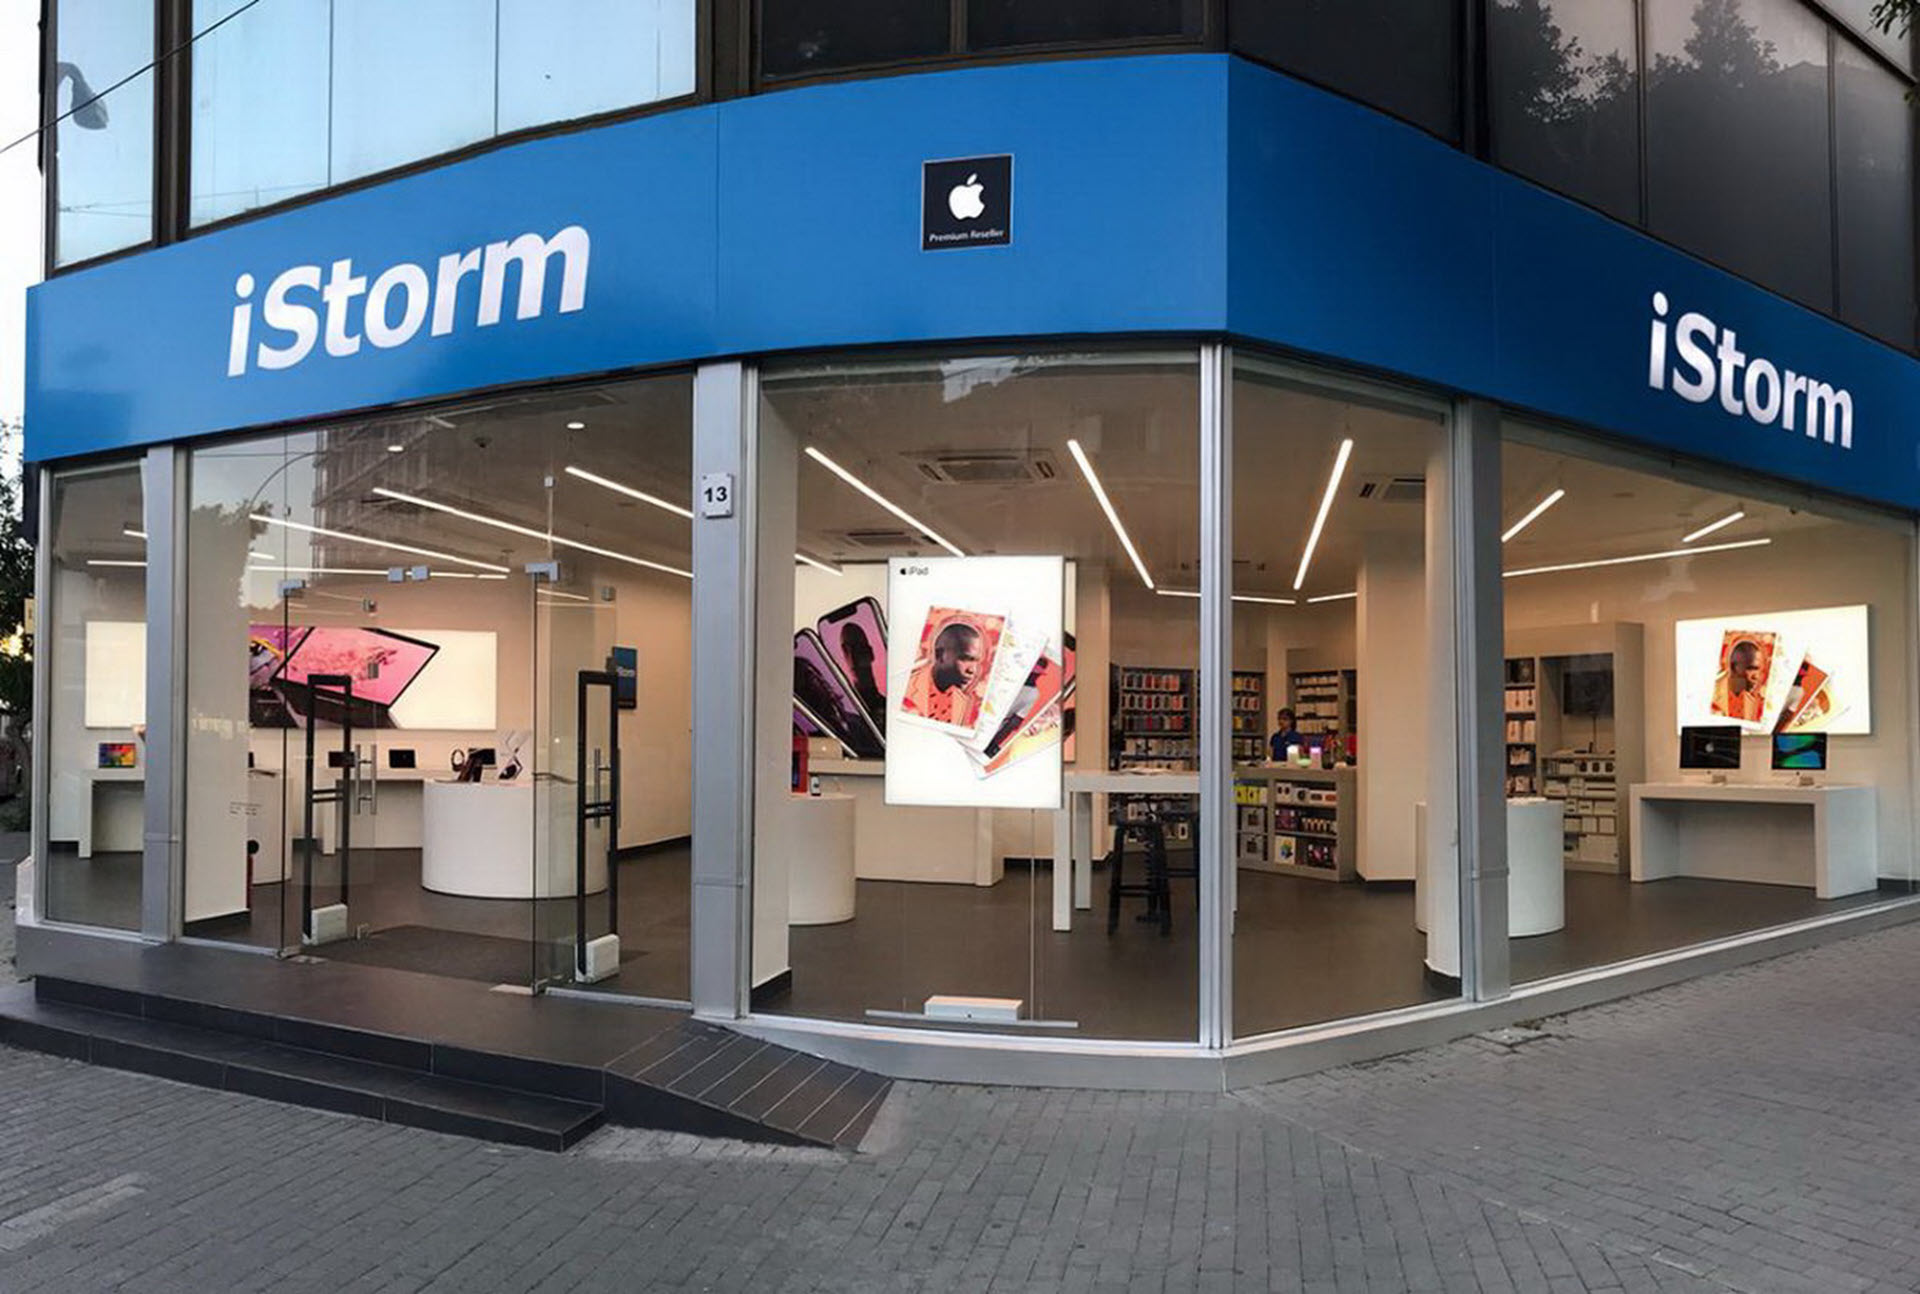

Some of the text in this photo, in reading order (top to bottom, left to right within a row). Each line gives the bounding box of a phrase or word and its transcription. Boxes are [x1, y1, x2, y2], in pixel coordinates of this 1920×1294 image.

[227, 225, 591, 378] iStorm
[1649, 291, 1854, 449] iStorm
[704, 486, 727, 502] 13
[908, 566, 929, 576] iPad
